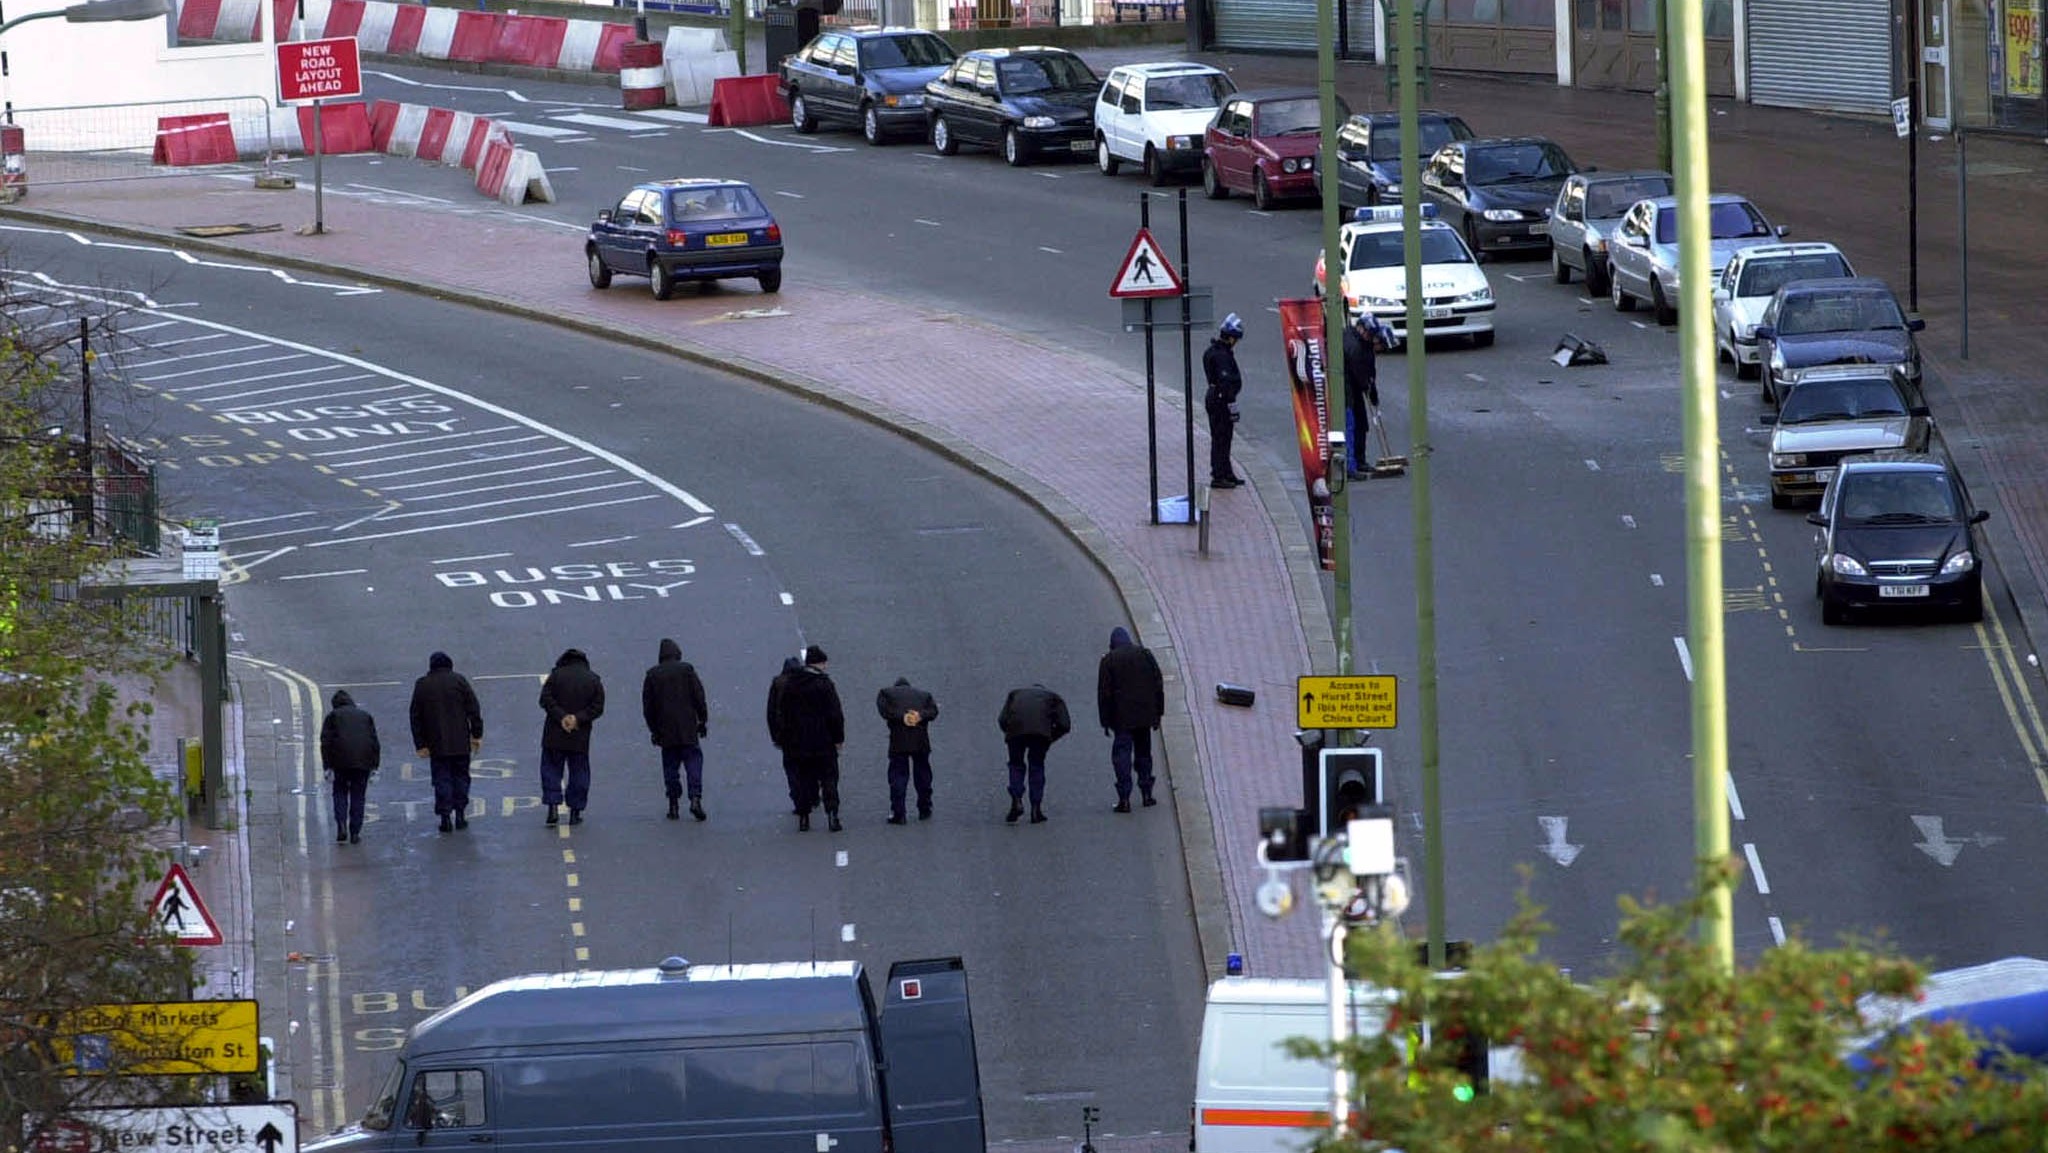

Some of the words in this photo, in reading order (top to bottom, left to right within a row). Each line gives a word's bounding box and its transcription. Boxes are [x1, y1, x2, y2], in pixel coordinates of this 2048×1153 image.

[302, 45, 331, 57] NEW
[300, 57, 335, 69] ROAD
[295, 68, 342, 82] LAYOUT
[299, 80, 342, 93] AHEAD
[223, 400, 453, 424] BUSES
[287, 419, 460, 441] ONLY
[434, 559, 696, 587] BUSES
[490, 580, 692, 608] ONLY
[1329, 681, 1365, 690] Access
[1369, 681, 1379, 689] to
[1321, 692, 1350, 701] Hurst
[1354, 692, 1388, 701] Street
[1340, 703, 1368, 712] Hotel
[1373, 703, 1392, 711] and
[1322, 714, 1352, 723] China
[1356, 714, 1387, 723] Court
[364, 797, 542, 824] TOP
[351, 986, 468, 1015] BU
[141, 1010, 219, 1026] Markets
[166, 1124, 246, 1146] Street
